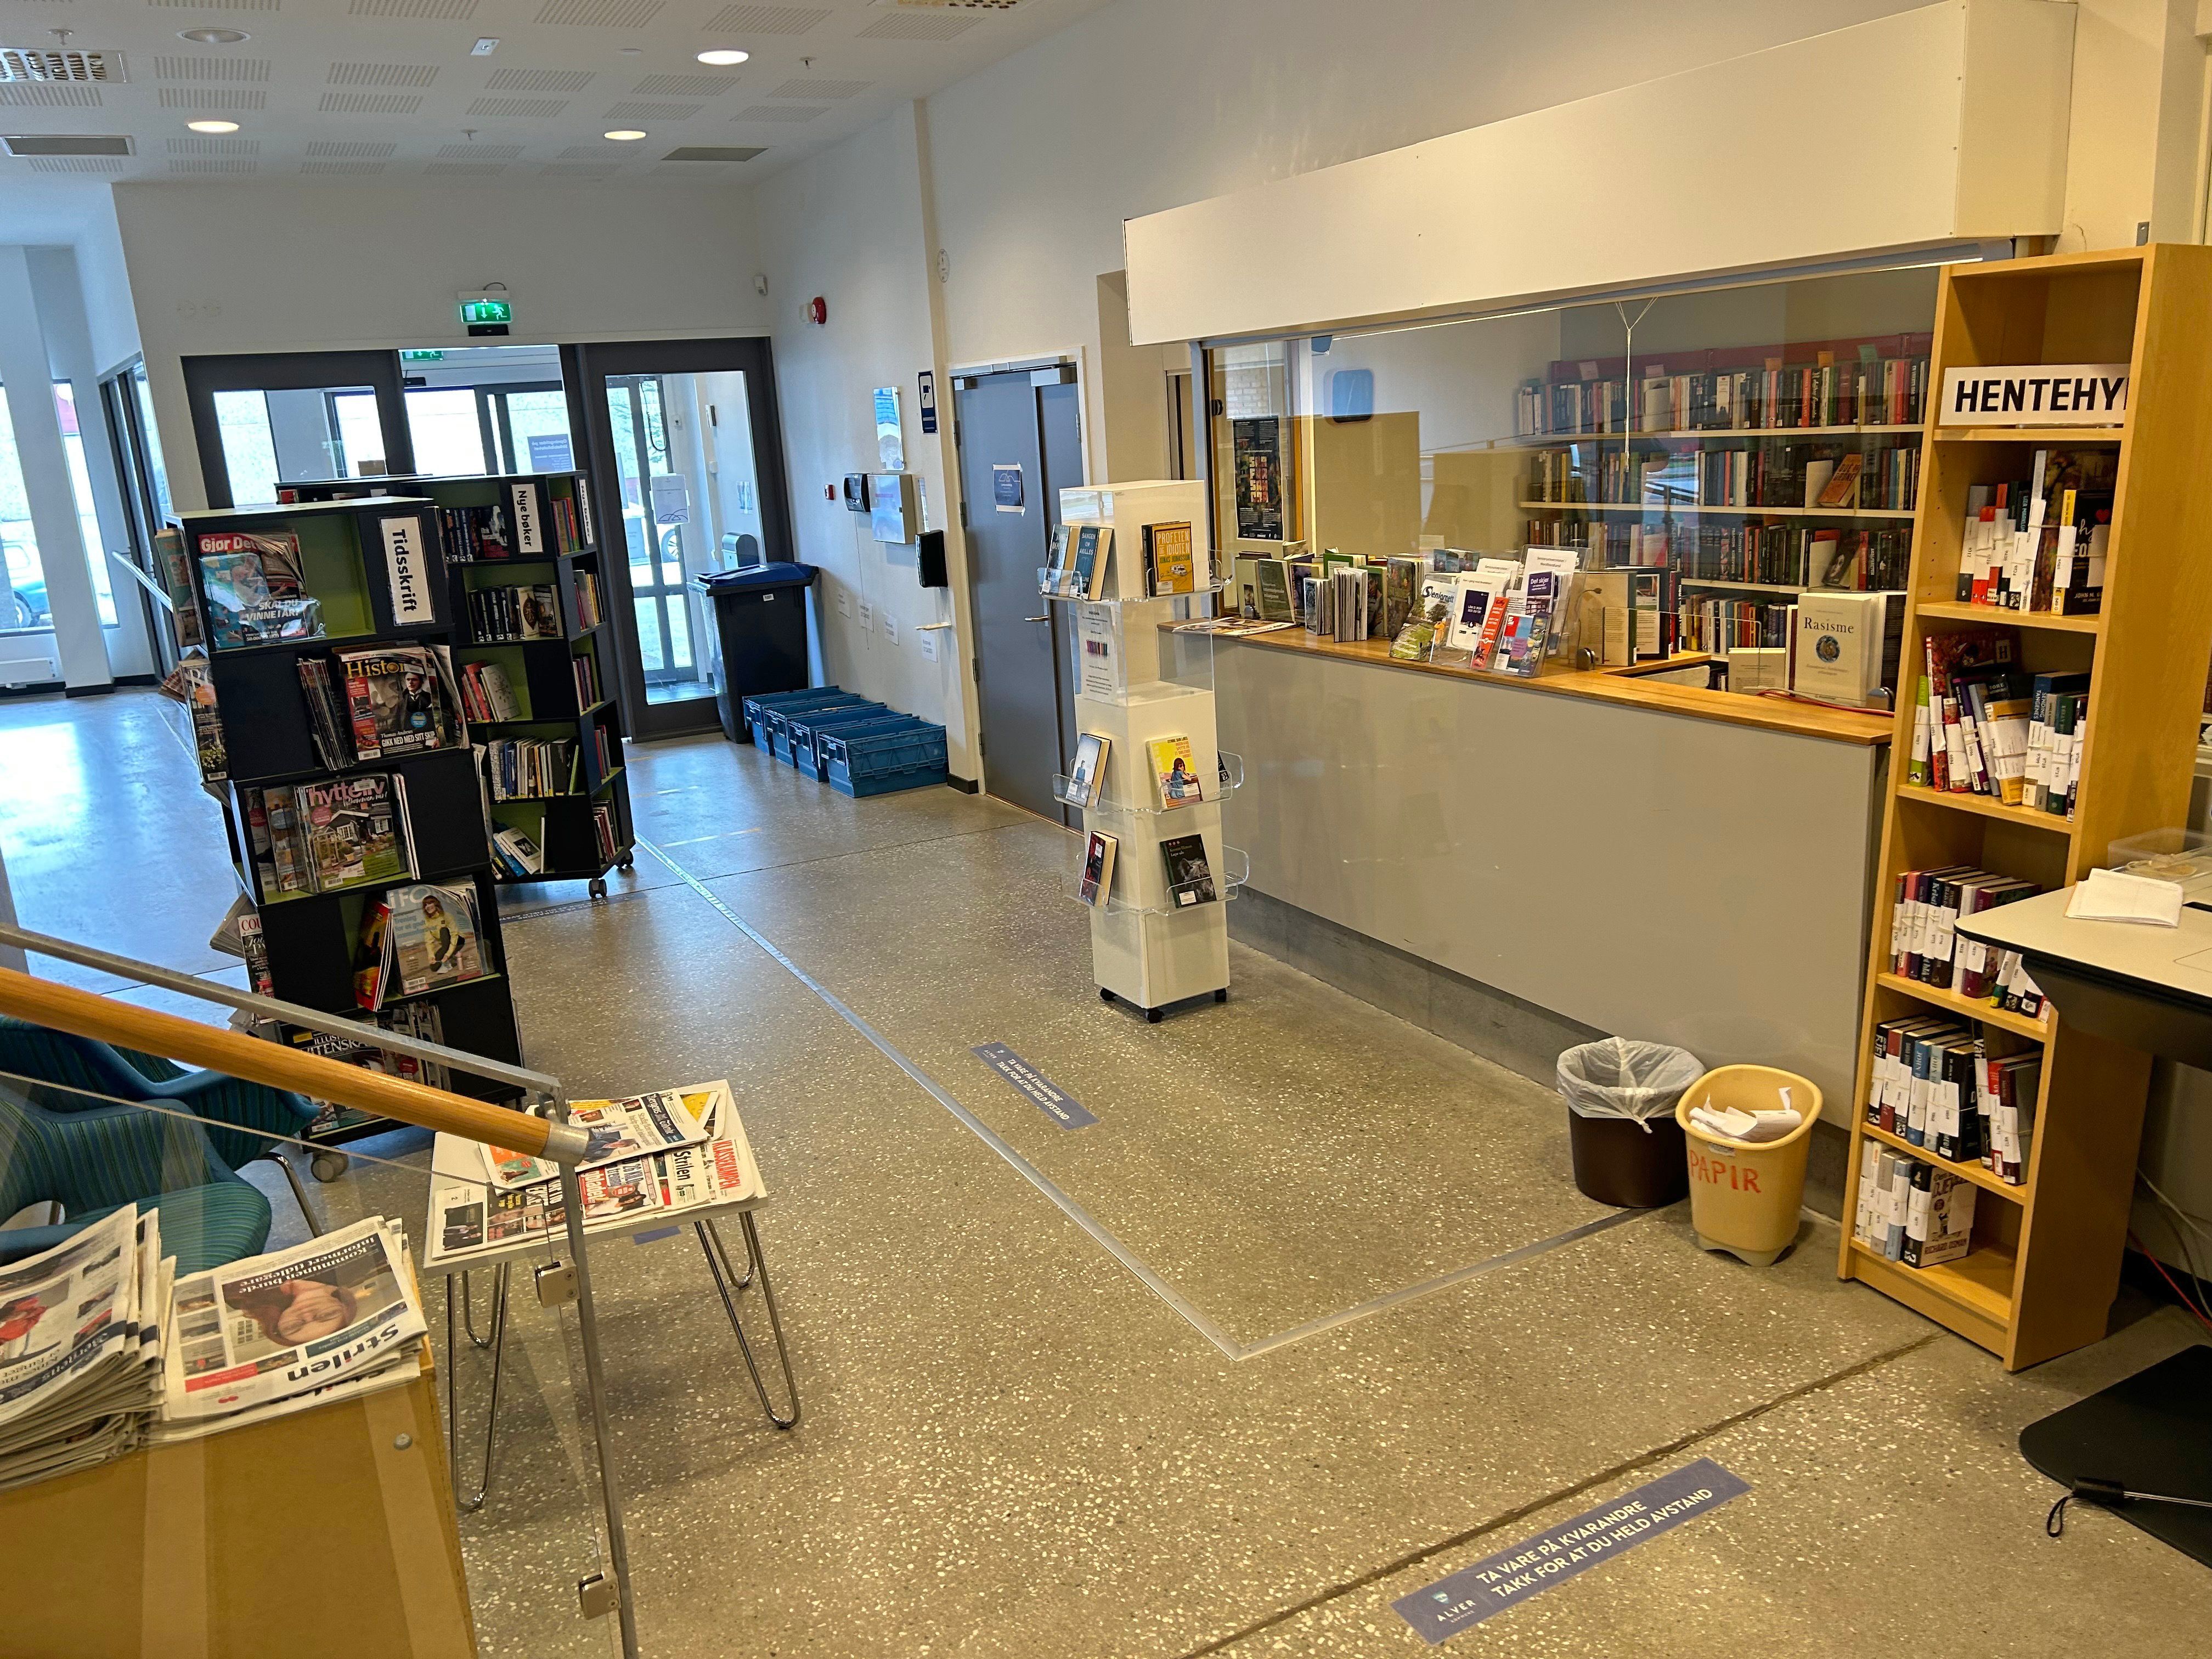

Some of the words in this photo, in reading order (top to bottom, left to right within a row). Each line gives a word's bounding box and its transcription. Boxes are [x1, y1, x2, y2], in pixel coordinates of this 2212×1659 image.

[1955, 377, 2130, 413] HENTEHY
[517, 490, 528, 512] Nye
[521, 512, 533, 547] bøker
[1157, 531, 1189, 544] PROFETEN
[1166, 543, 1190, 555] IDIOTEN
[392, 529, 417, 612] Tidsskrift
[247, 611, 278, 621] VINNE
[258, 601, 281, 611] SKAL
[282, 599, 299, 608] DU
[1804, 617, 1854, 634] Rasisme
[2033, 690, 2042, 720] TANGENES
[382, 738, 394, 748] GIKK
[394, 737, 403, 746] NED
[404, 735, 414, 744] MED
[415, 733, 425, 741] SITT
[1009, 1070, 1020, 1080] FOR
[1030, 1089, 1048, 1102] HELD
[1042, 1101, 1070, 1120] AVSTAND
[674, 1150, 693, 1181] Strilen
[712, 1139, 741, 1190] KLASSEKAMPEN
[1689, 1149, 1762, 1194] PAPIR
[284, 1246, 368, 1283] Kommunen
[238, 1276, 283, 1295] burde
[286, 1323, 399, 1383] Strilen
[1476, 1571, 1502, 1586] TA
[1497, 1550, 1542, 1581] VARE
[1537, 1538, 1562, 1558] PÅ
[1557, 1499, 1649, 1548] KVARANDRE
[1491, 1571, 1539, 1599] TAKK
[1536, 1556, 1571, 1578] FOR
[1567, 1545, 1591, 1565] AT
[1587, 1535, 1611, 1554] DU
[1612, 1517, 1651, 1543] HELD
[1650, 1488, 1714, 1525] AVSTAND
[1436, 1599, 1476, 1622] ALVER
